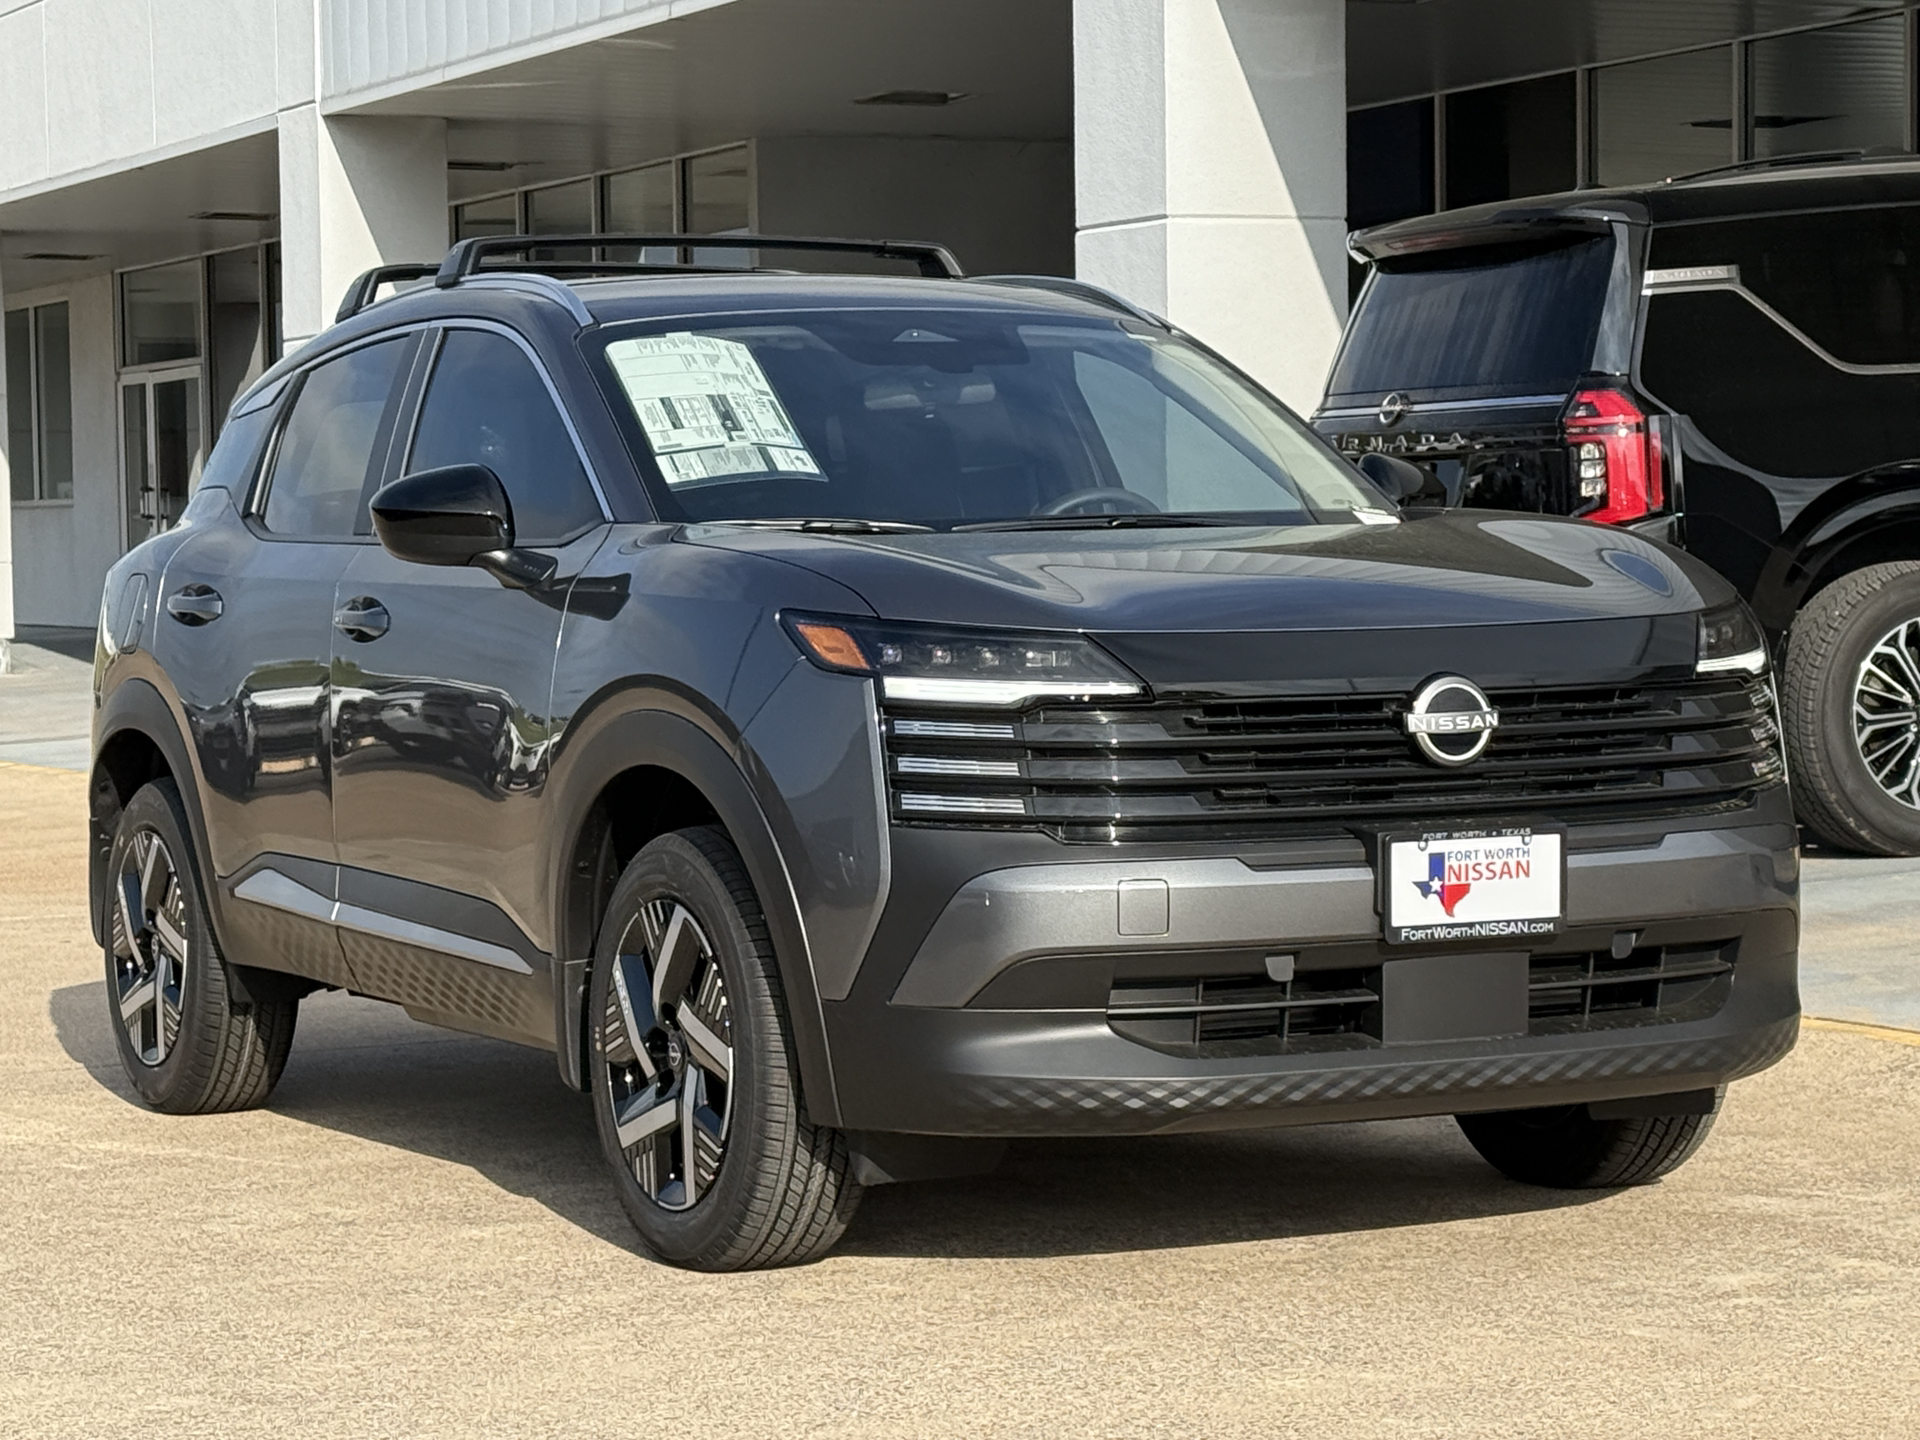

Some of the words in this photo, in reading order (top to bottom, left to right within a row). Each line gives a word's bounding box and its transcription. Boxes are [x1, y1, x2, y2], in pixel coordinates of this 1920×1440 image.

[1410, 712, 1498, 731] NISSAN
[1421, 832, 1448, 841] FORT
[1452, 830, 1487, 839] WORTH
[1501, 828, 1531, 837] TEXAS
[1447, 849, 1480, 862] FORT
[1484, 847, 1530, 860] WORTH
[1447, 860, 1530, 883] NISSAN
